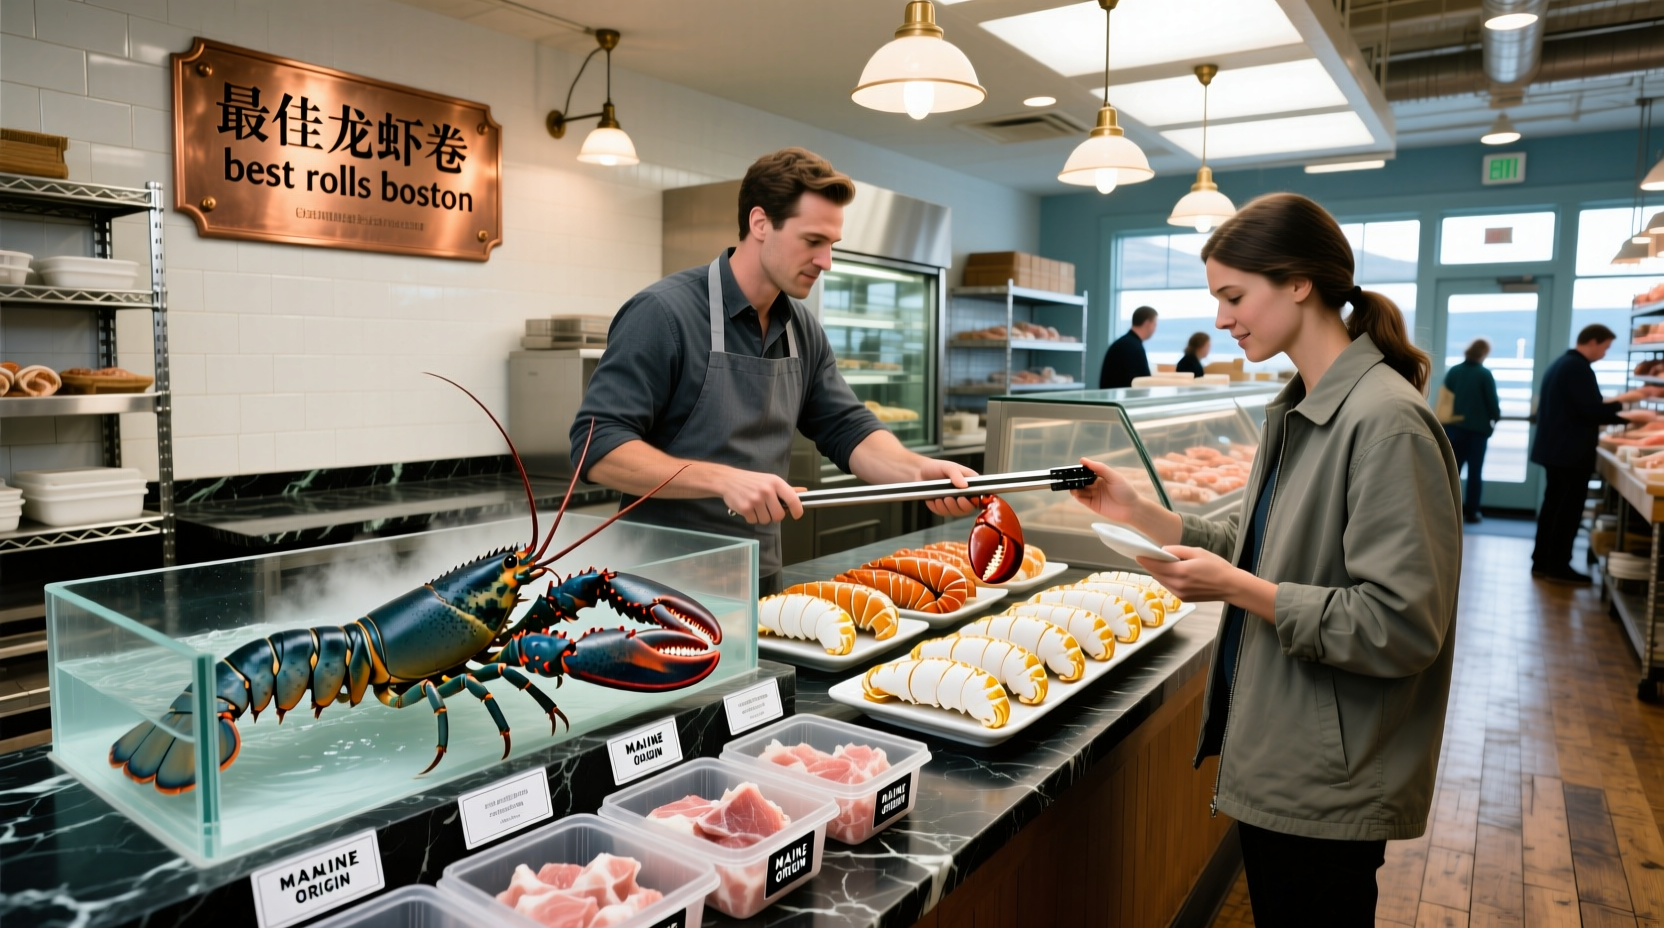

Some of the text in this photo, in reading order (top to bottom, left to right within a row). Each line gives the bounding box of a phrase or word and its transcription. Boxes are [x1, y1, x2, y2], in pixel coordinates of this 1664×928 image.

[216, 81, 468, 174] 最佳龙虾卷
[224, 146, 473, 213] best rolls boston
[295, 871, 351, 904] ORIGIN
